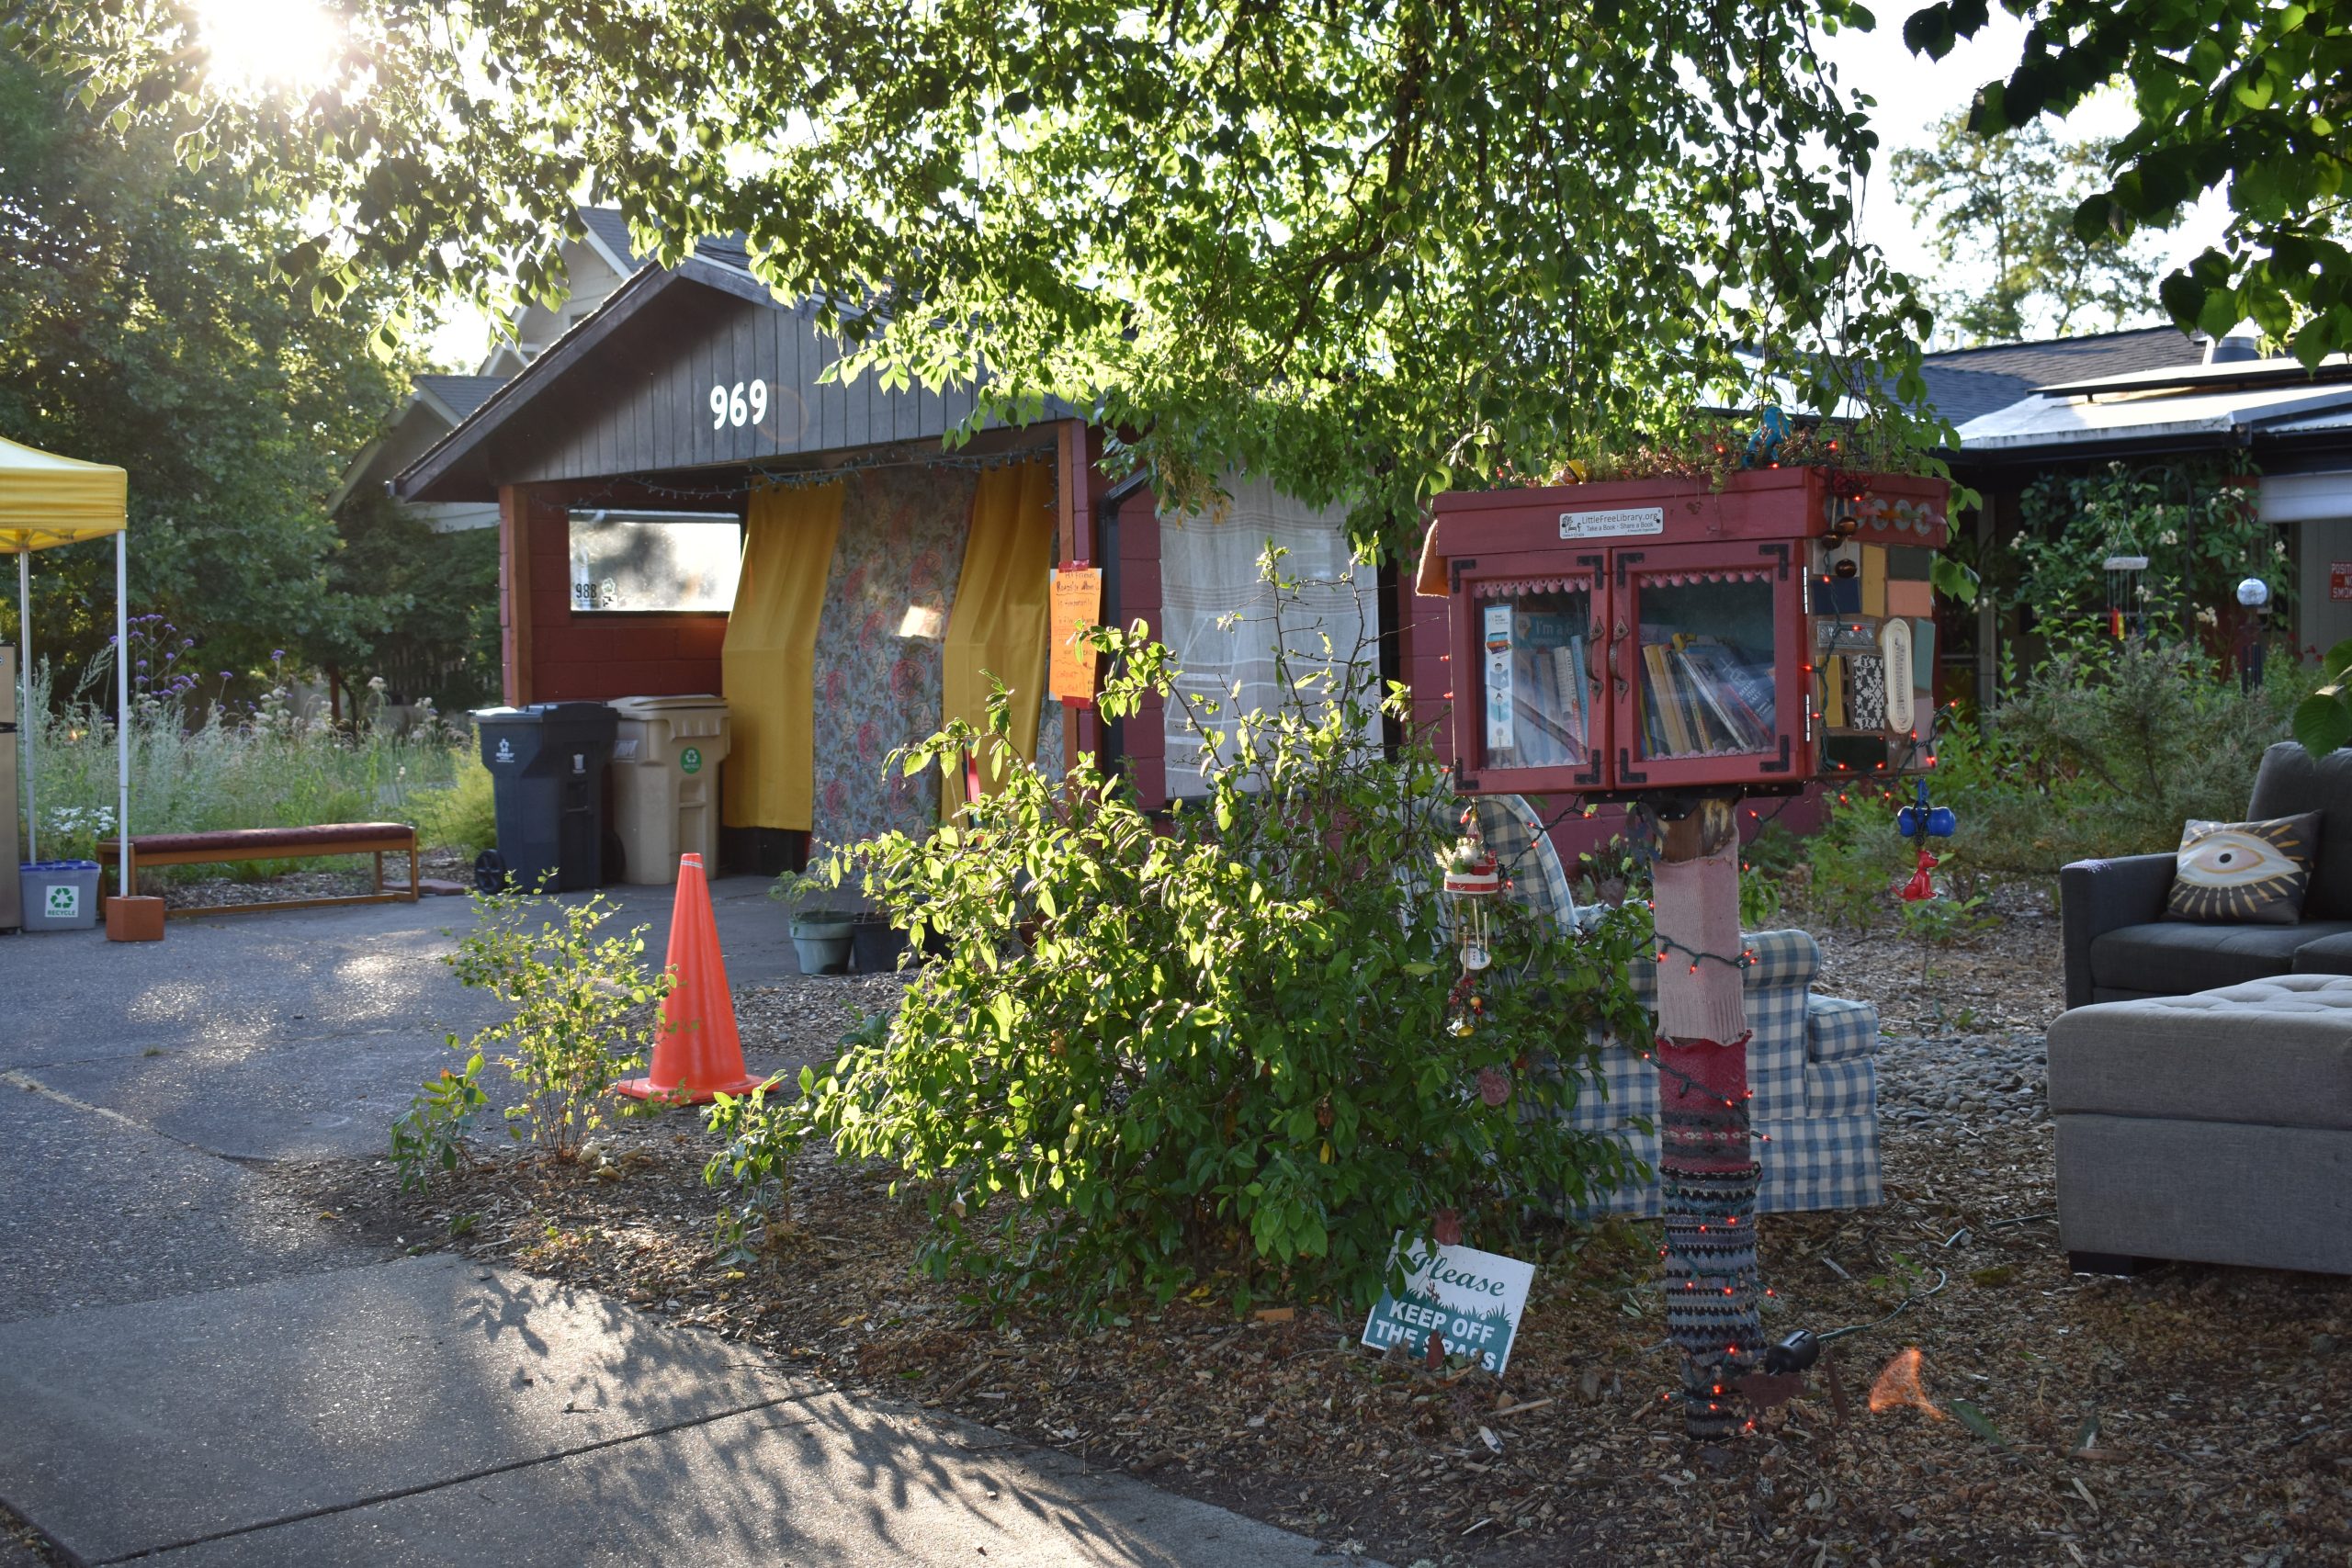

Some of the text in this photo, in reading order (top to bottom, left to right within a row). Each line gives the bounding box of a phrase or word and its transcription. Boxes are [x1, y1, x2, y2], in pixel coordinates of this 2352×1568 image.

[710, 378, 767, 430] 969
[1581, 513, 1658, 525] LittleFreeLibrary.org
[1640, 520, 1654, 528] Book
[1412, 1251, 1505, 1296] Please
[1376, 1319, 1419, 1348] THE
[1388, 1300, 1495, 1344] KEEP OFF
